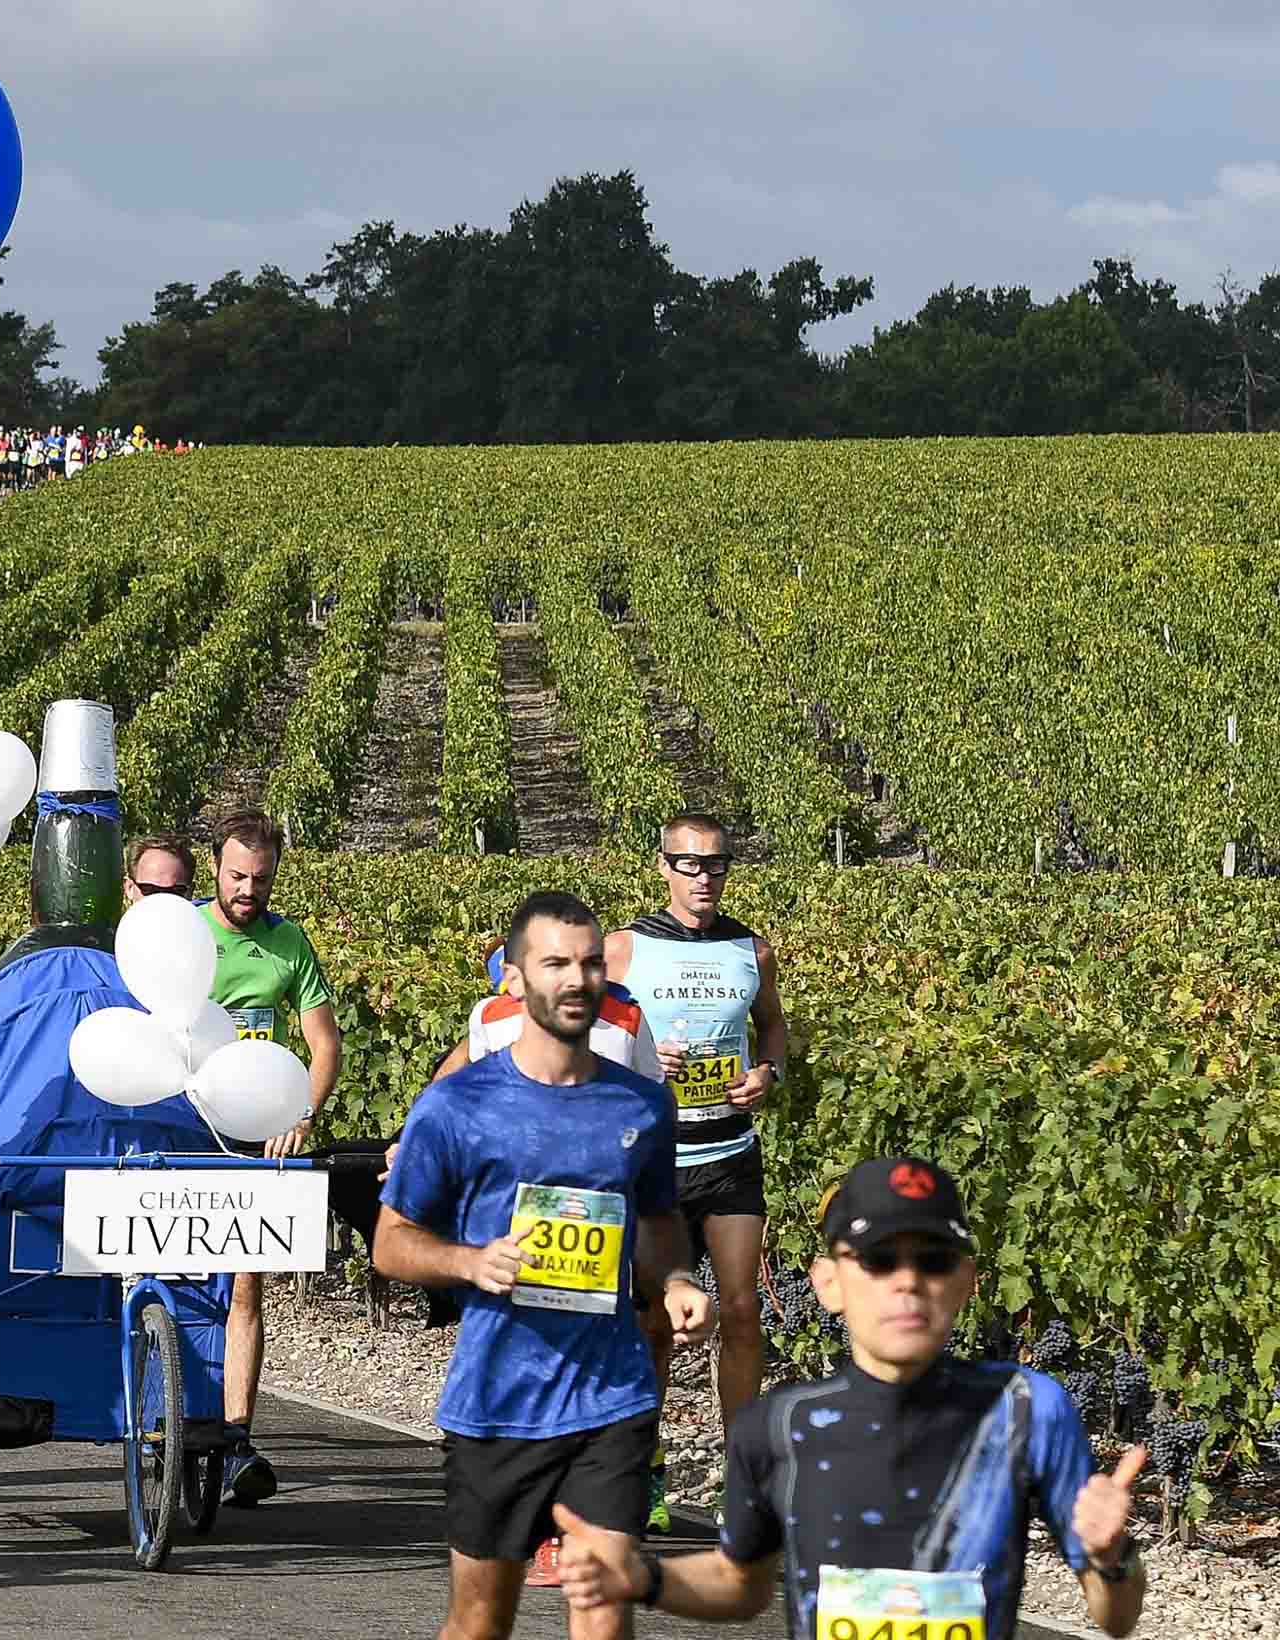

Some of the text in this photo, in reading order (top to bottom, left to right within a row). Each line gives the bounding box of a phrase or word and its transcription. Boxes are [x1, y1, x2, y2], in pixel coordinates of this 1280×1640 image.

[653, 987, 748, 1000] CAMENSAC
[96, 1216, 296, 1256] LIVRAN
[533, 1219, 605, 1256] 300
